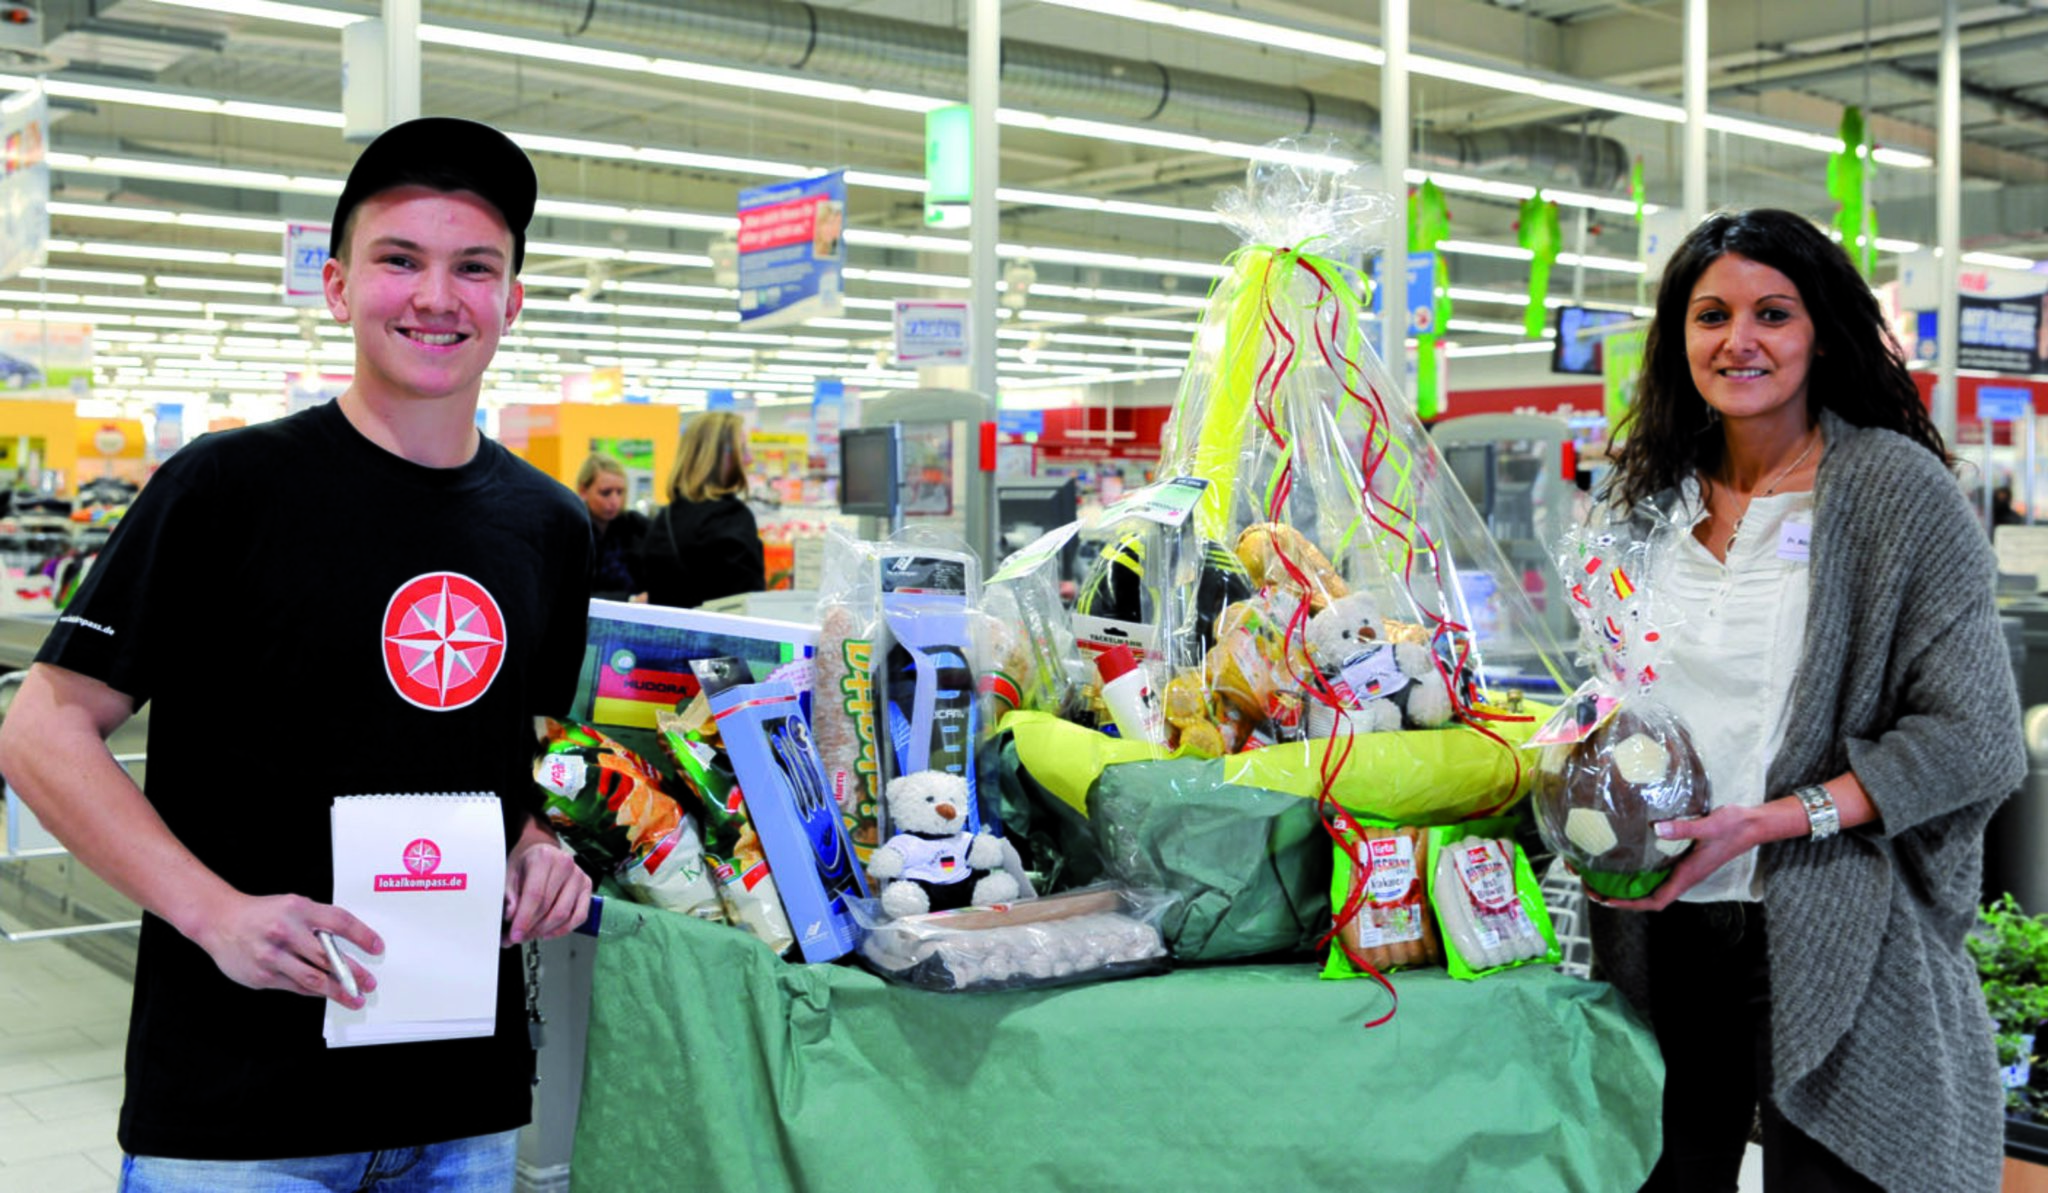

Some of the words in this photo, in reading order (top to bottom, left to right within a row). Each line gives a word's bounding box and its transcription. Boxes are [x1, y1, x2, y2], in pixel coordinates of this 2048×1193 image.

[624, 681, 687, 695] HUDORA
[834, 771, 847, 801] Harry
[378, 876, 463, 891] lokalkompass.de
